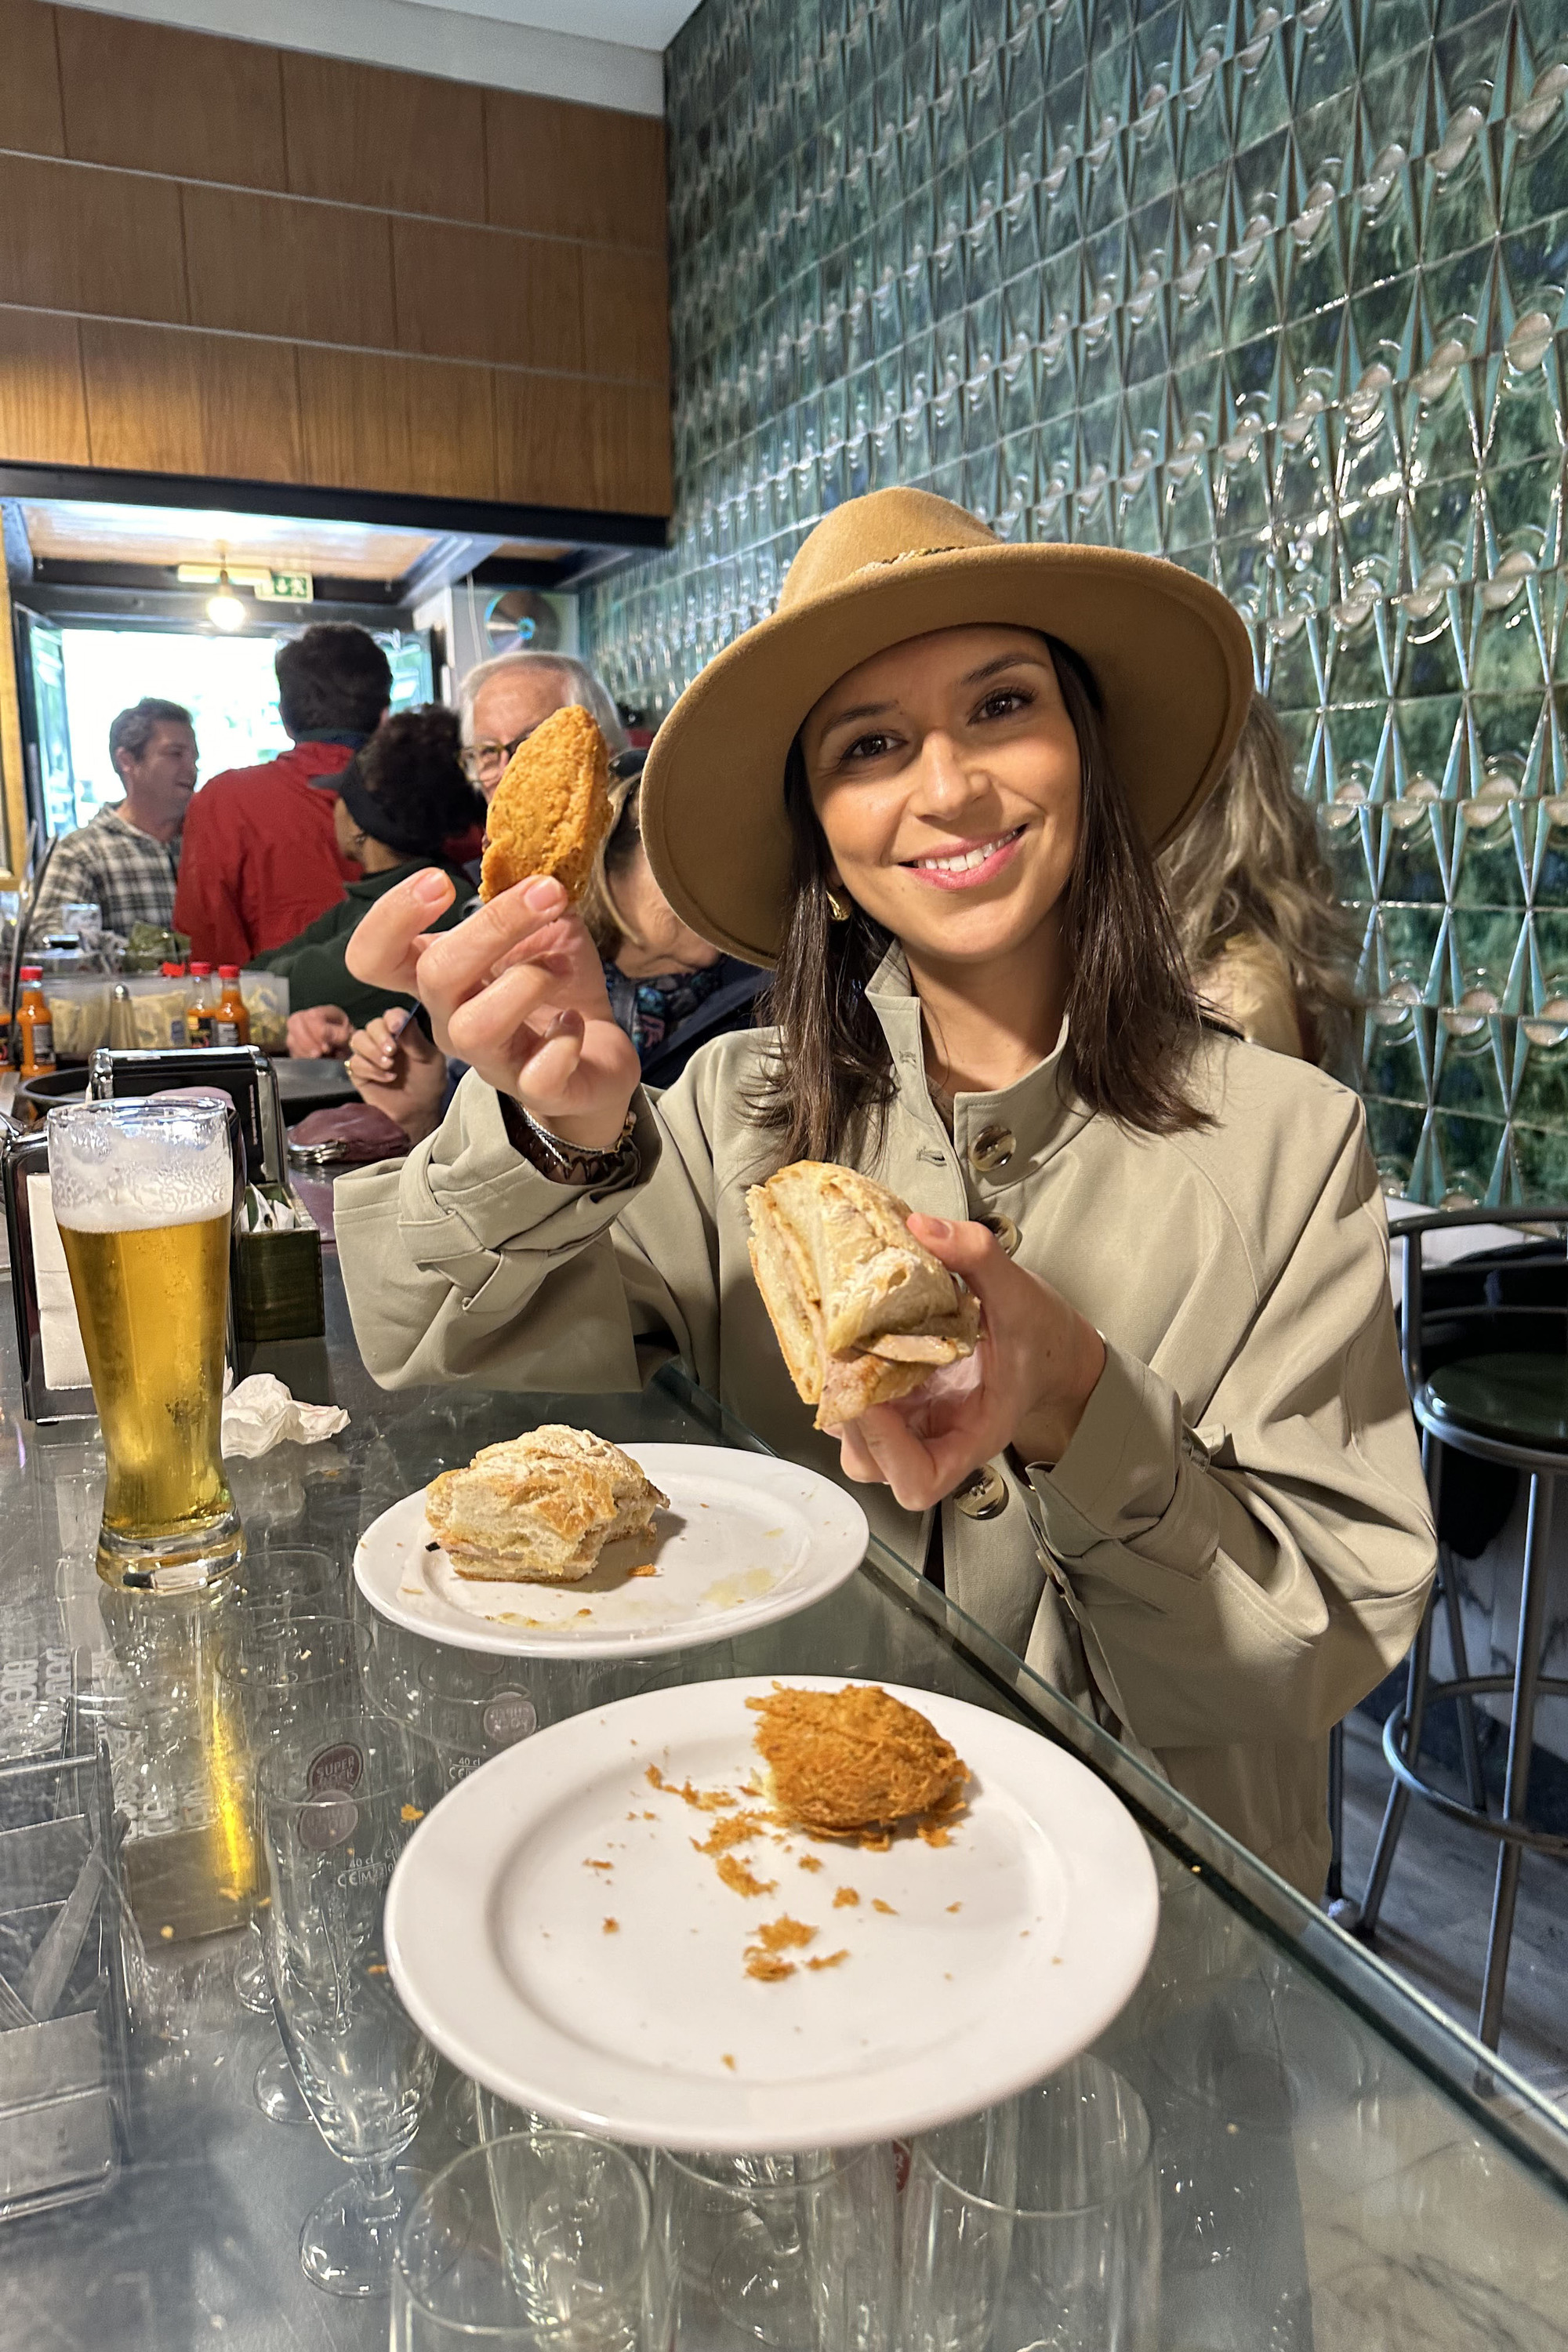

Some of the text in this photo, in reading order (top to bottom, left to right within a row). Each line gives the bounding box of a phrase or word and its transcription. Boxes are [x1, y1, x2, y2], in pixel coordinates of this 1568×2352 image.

[316, 1755, 354, 1777] SUPER
[459, 1757, 481, 1766] 40 cl
